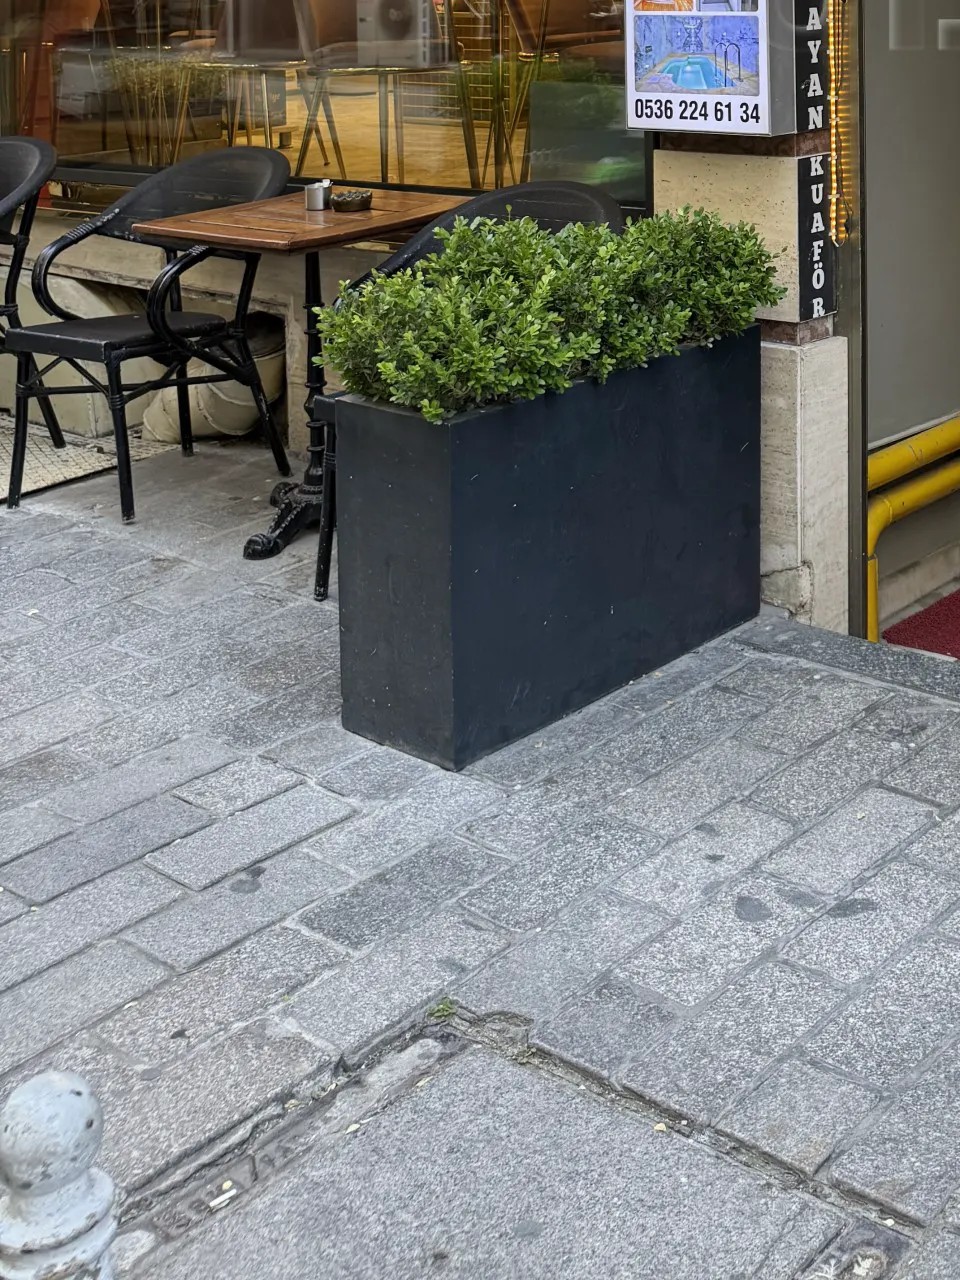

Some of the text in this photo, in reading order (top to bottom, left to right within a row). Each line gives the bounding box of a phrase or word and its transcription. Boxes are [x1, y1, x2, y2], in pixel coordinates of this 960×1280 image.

[634, 98, 761, 124] 0536 224 61 34
[810, 155, 826, 318] KUAFÖR
